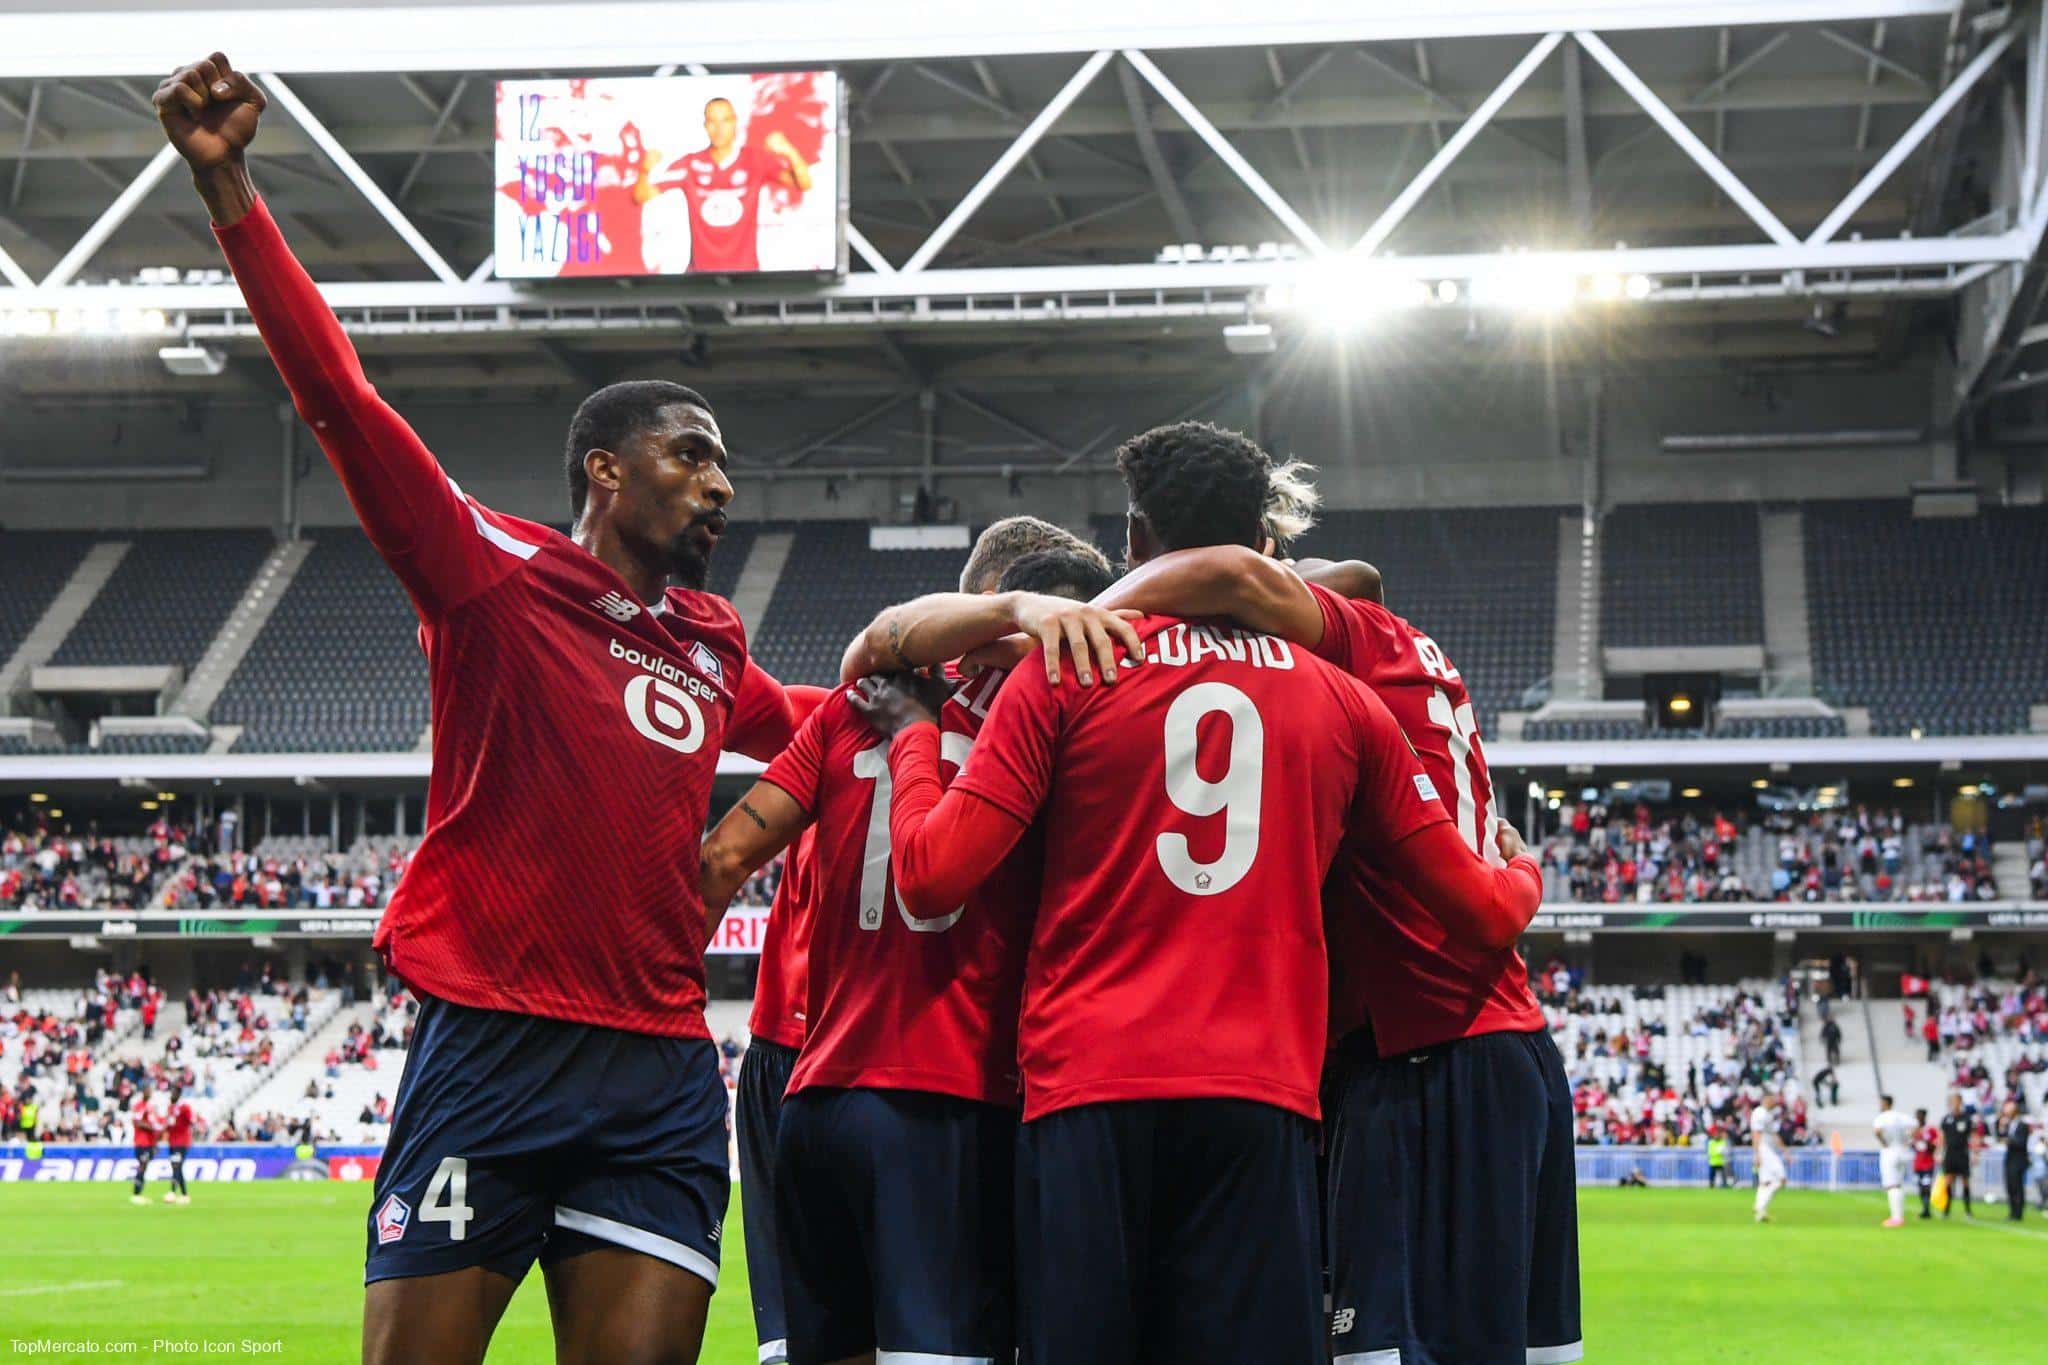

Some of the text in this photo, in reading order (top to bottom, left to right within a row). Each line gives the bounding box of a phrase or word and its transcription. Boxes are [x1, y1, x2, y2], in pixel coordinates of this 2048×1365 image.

[609, 638, 718, 704] boulanger
[1156, 682, 1264, 895] 9
[418, 1157, 474, 1240] 4
